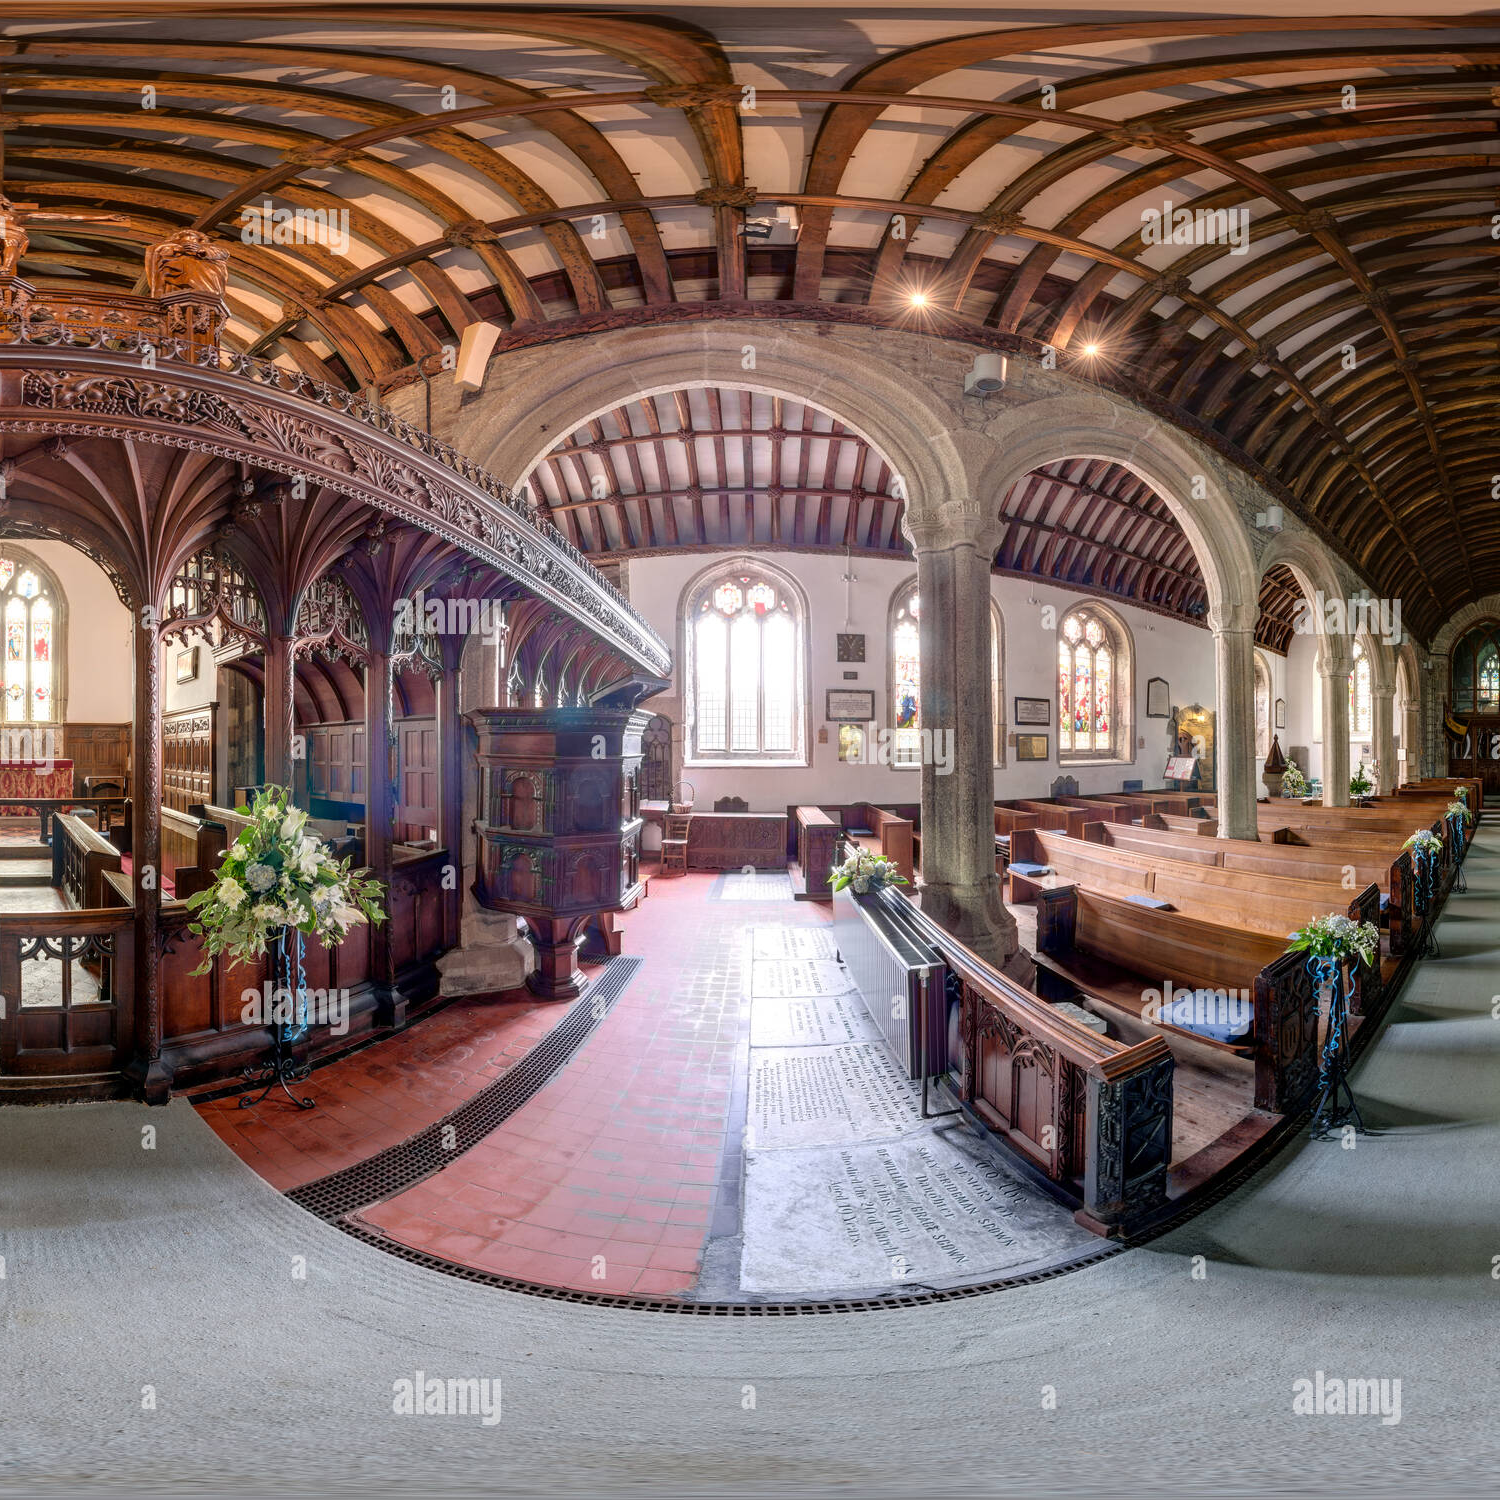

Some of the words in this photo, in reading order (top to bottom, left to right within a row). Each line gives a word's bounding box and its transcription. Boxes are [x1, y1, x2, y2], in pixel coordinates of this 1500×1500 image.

[915, 1147, 940, 1170] SALLY
[826, 1180, 848, 1201] Aged
[881, 1159, 907, 1189] WILLIAM
[908, 1206, 940, 1232] GRACE
[913, 1175, 959, 1218] Daughter
[950, 1162, 996, 1202] MEMORY
[844, 1166, 862, 1183] died
[871, 1226, 900, 1253] March
